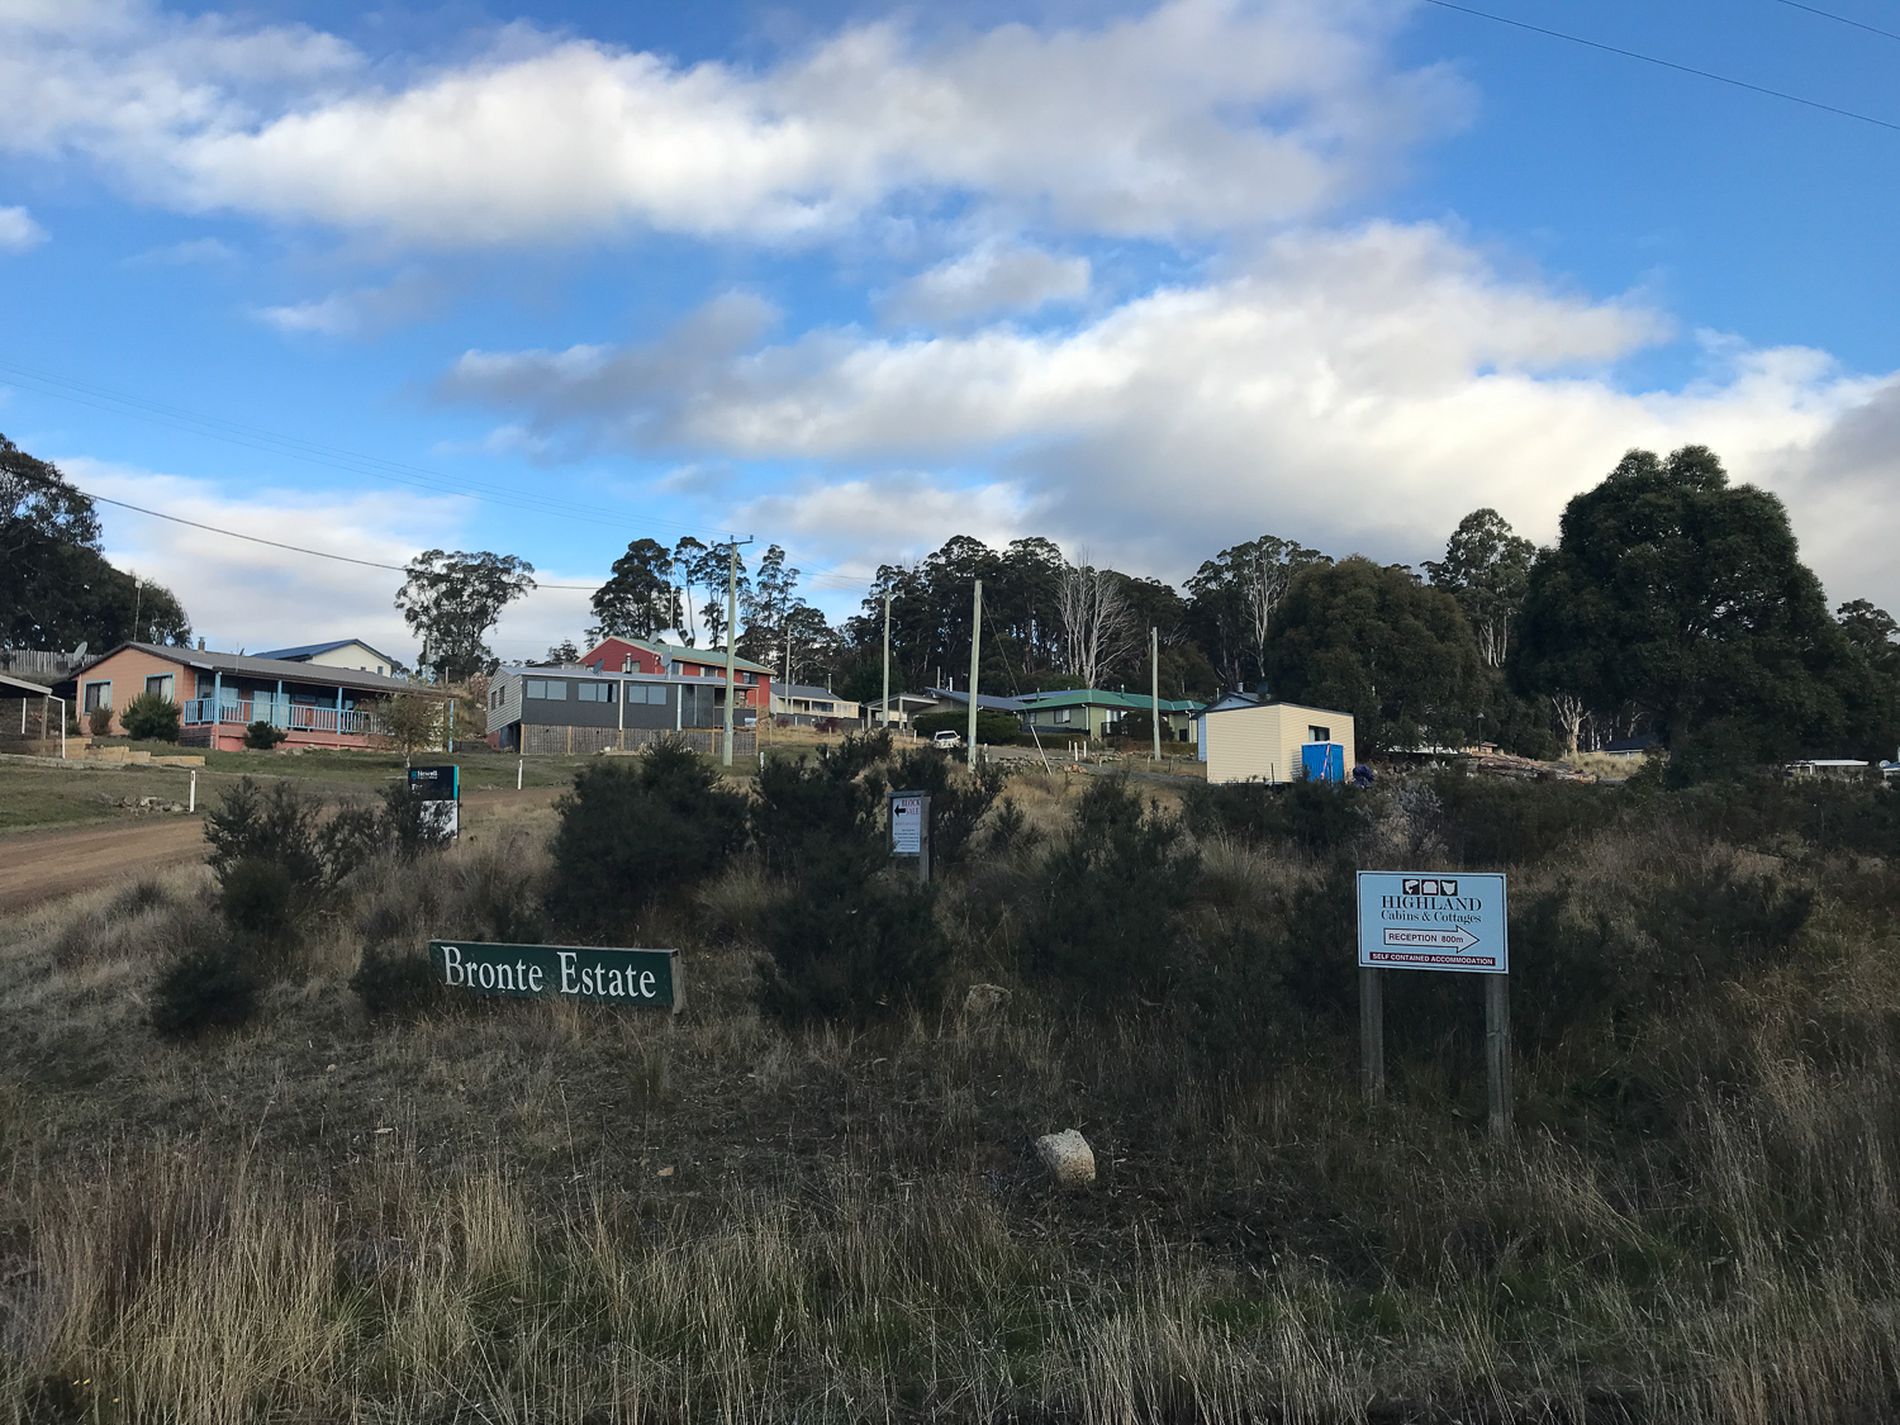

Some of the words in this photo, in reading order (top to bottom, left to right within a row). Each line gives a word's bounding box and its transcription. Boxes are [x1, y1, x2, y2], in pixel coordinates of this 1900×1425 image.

[1381, 896, 1482, 911] HIGHLAND
[1381, 910, 1419, 921] Cabins
[1422, 912, 1431, 922] &
[1434, 911, 1482, 925] Cottages
[1388, 933, 1437, 942] RECEPTION
[1390, 954, 1430, 962] CONTAINED
[1431, 955, 1494, 965] ACCOMMODATION
[441, 946, 544, 992] Bronte
[557, 951, 657, 998] Estate
